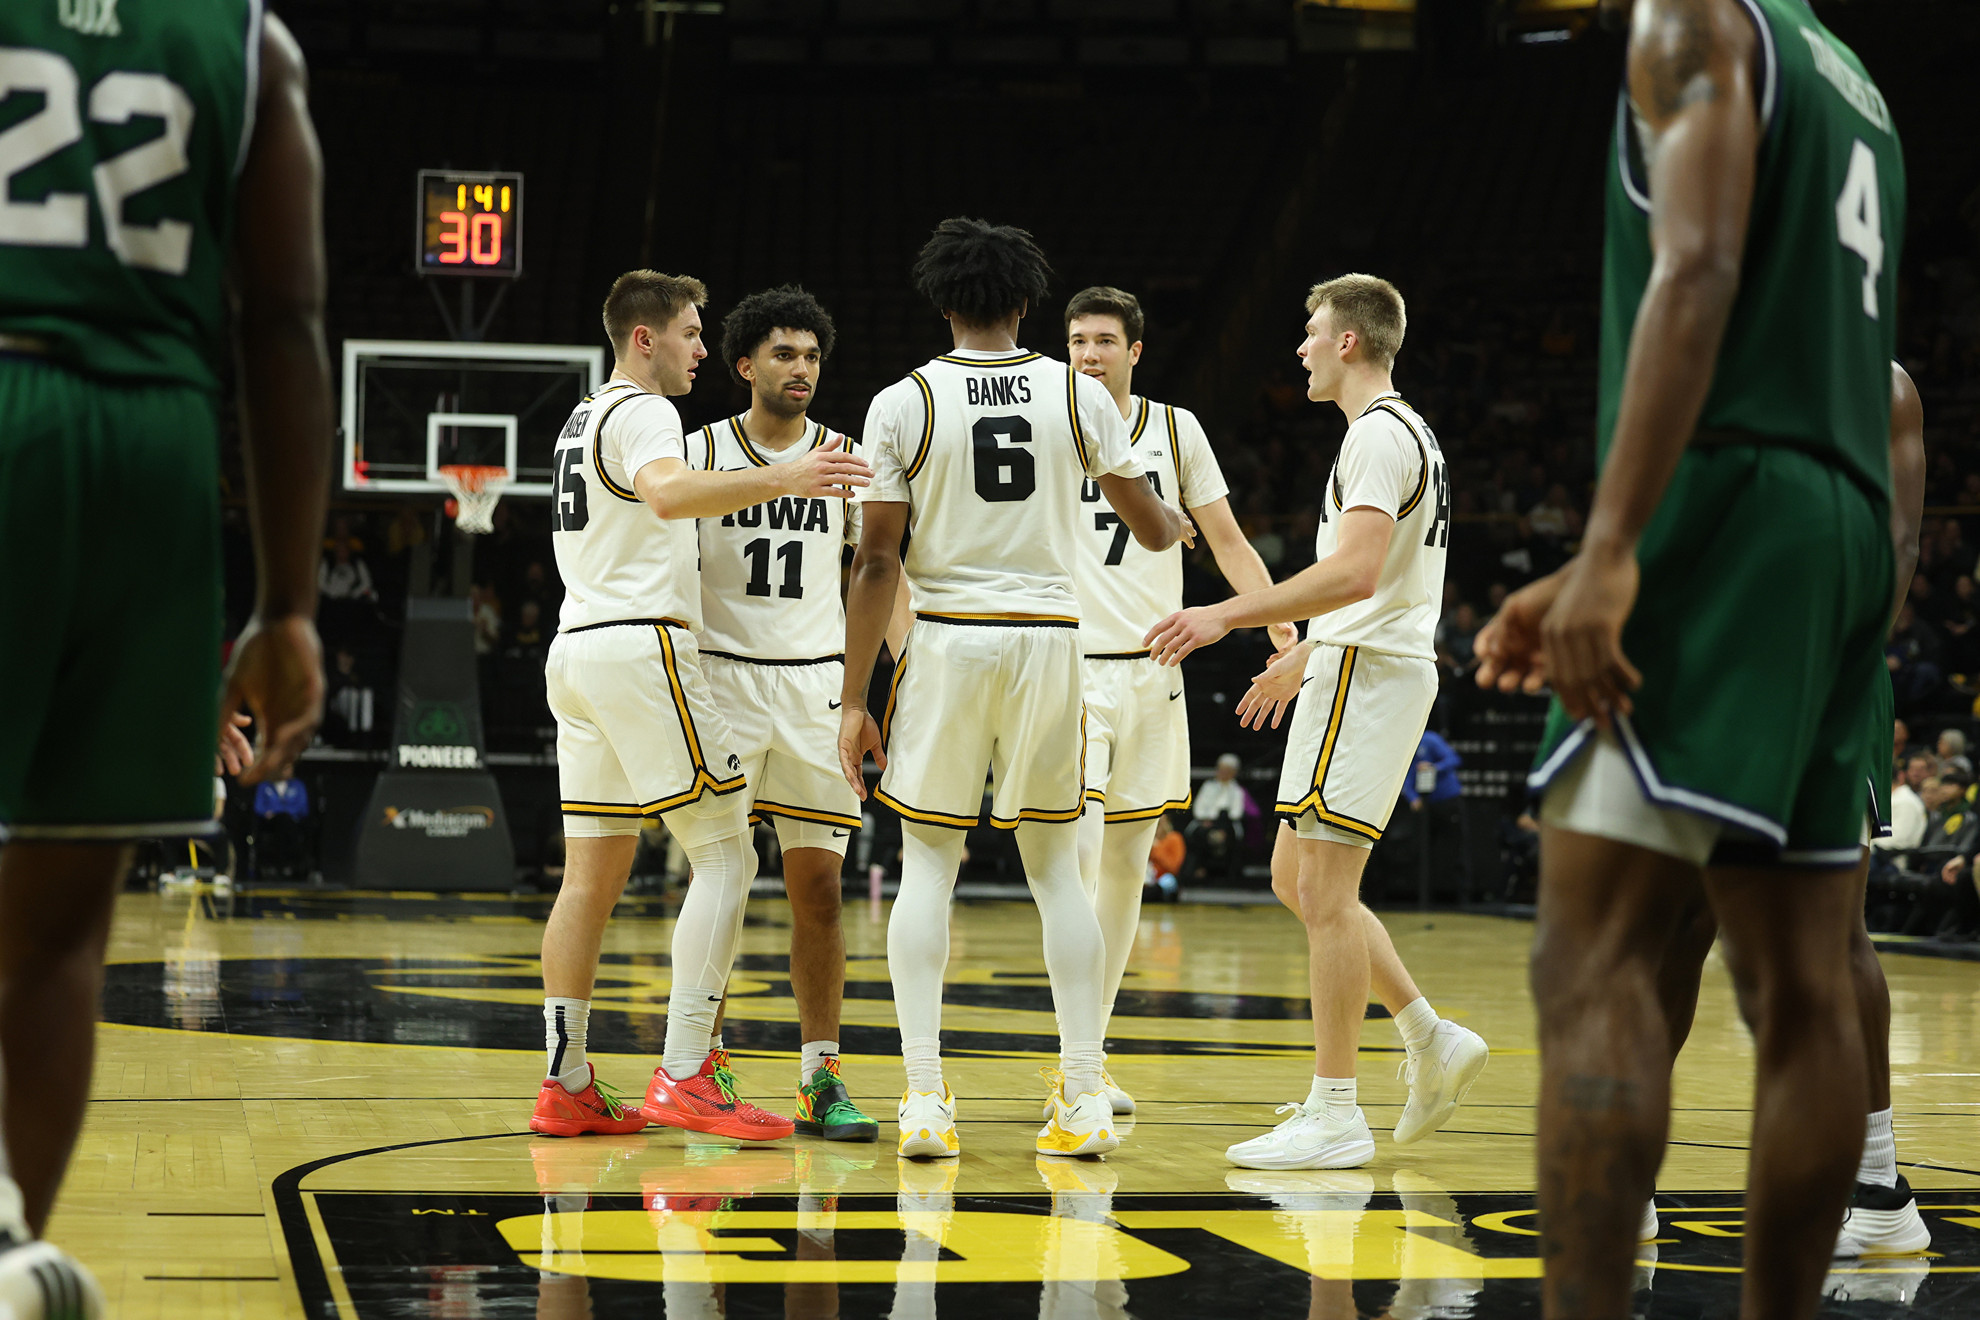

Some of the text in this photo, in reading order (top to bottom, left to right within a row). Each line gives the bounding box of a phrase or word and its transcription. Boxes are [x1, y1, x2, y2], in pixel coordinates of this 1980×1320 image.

[0, 47, 195, 276] 22
[438, 211, 502, 265] 30
[1835, 136, 1884, 322] 4
[965, 375, 1032, 406] BANKS
[552, 447, 590, 532] 15
[972, 414, 1036, 503] 6
[743, 537, 804, 600] 11
[1094, 512, 1131, 566] 7
